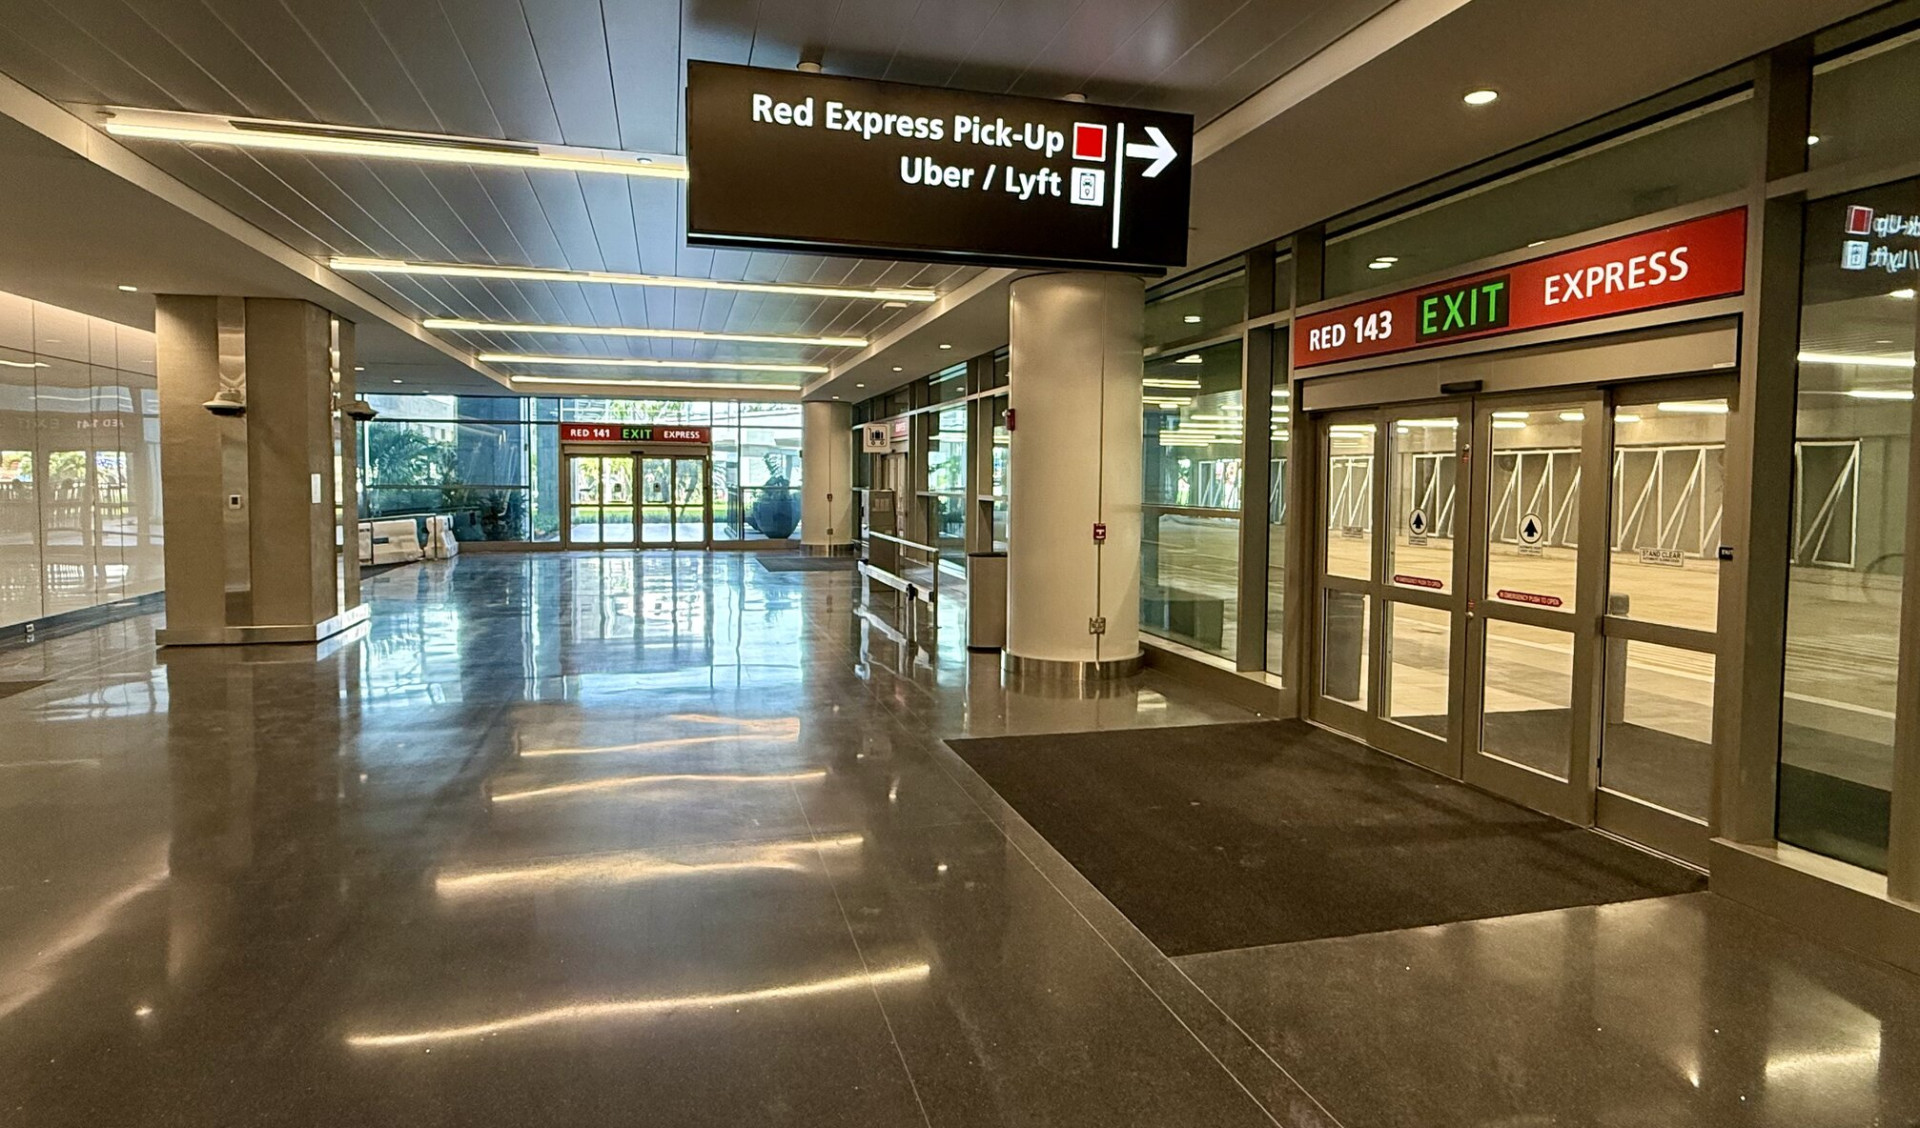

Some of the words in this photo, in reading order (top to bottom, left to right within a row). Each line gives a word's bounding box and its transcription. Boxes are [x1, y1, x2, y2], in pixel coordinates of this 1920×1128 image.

[752, 94, 814, 127] Red
[825, 102, 944, 140] Express
[953, 115, 1065, 158] Pick-Up
[900, 156, 974, 190] Uber
[982, 164, 996, 191] /
[1005, 167, 1062, 201] Lyft
[1544, 246, 1690, 306] EXPRESS
[1422, 282, 1504, 334] EXIT
[1308, 322, 1346, 351] RED
[1353, 310, 1393, 344] 143
[570, 428, 590, 438] RED
[593, 429, 610, 438] 141
[622, 429, 652, 439] EXIT
[663, 431, 700, 439] EXPRESS
[1642, 550, 1660, 558] STAND
